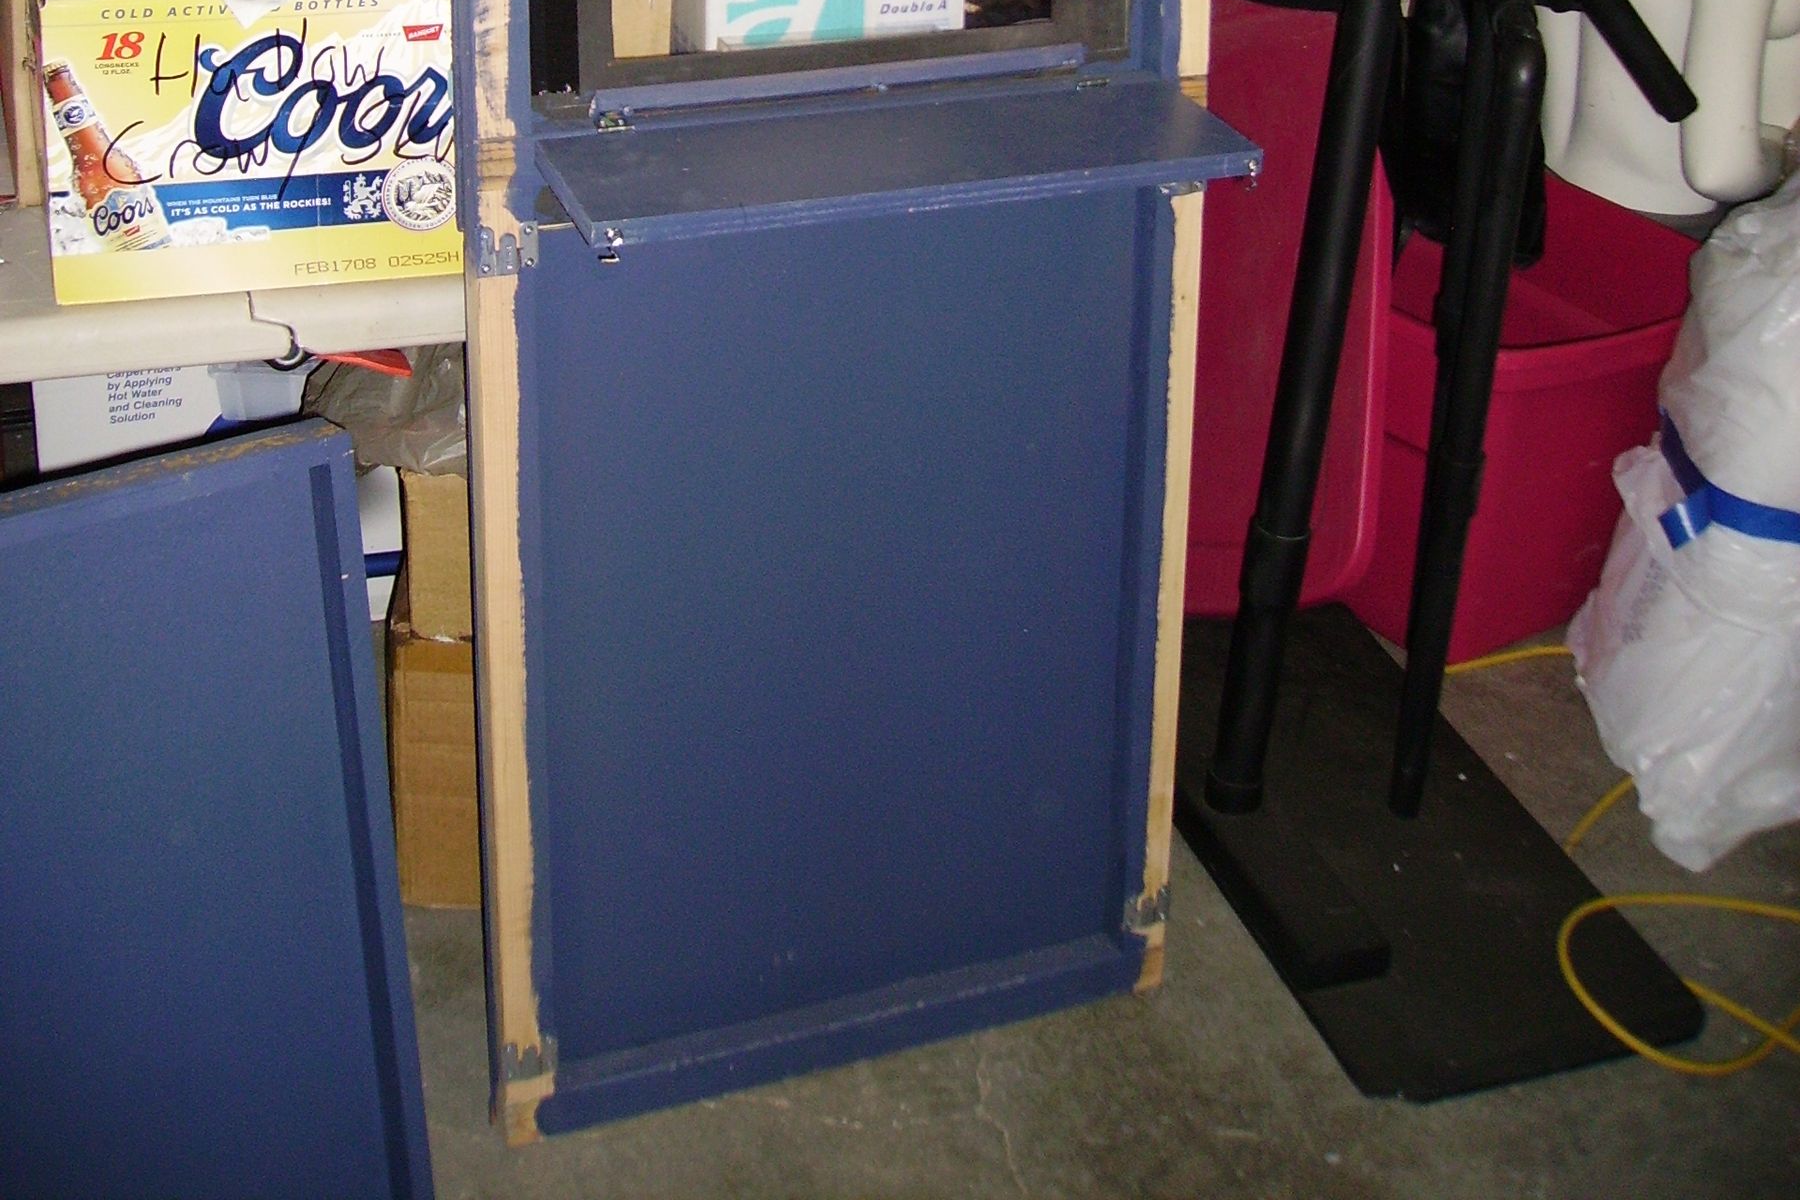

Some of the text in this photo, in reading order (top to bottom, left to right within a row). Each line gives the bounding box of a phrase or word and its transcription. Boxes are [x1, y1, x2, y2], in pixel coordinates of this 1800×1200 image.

[101, 8, 154, 19] COLD
[880, 0, 947, 15] Double A
[96, 31, 145, 61] 18
[195, 34, 453, 158] Coor
[171, 197, 332, 217] IT'S AS COLD AS THE ROCKIES!
[90, 198, 154, 238] Coors
[294, 251, 460, 276] FEB1708 02525H
[107, 376, 173, 392] by Applying
[108, 389, 163, 402] Hot Water
[109, 398, 183, 413] and Cleaning
[110, 412, 156, 425] Solution
